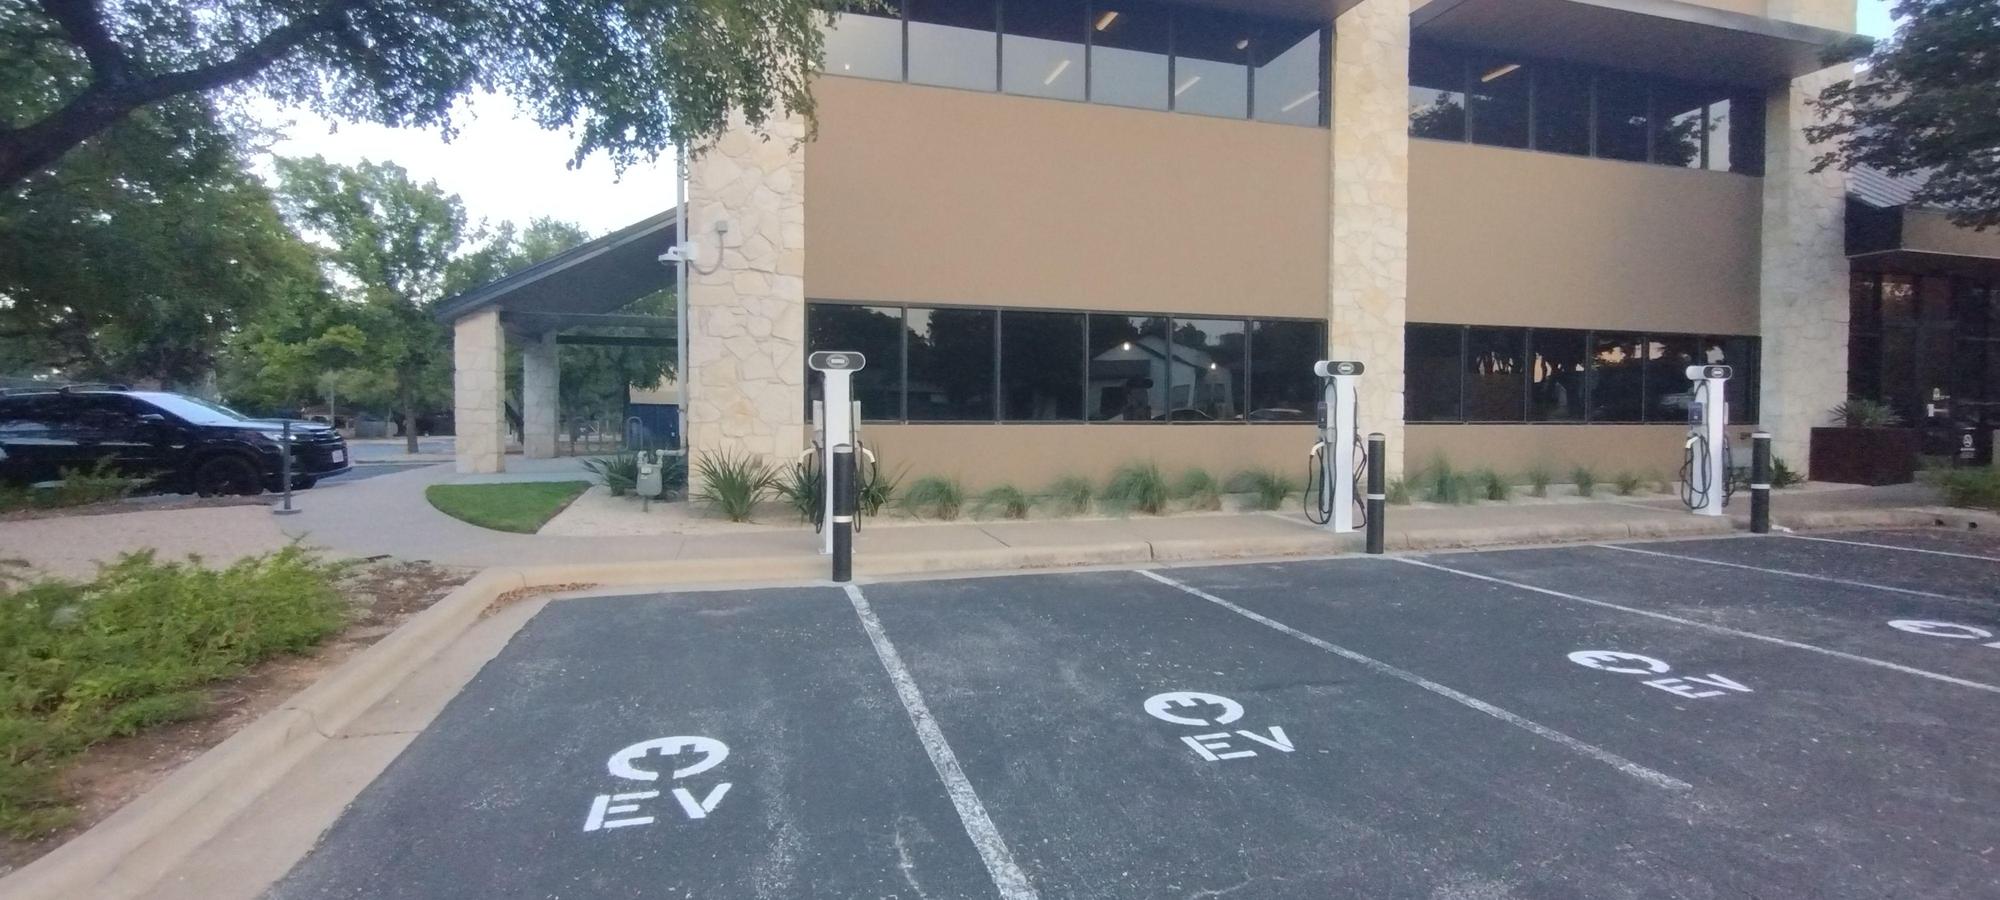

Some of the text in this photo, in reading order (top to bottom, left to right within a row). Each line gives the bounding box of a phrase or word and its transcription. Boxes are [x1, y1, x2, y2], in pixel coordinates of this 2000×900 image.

[1642, 673, 1754, 699] EV
[1180, 725, 1296, 762] EV
[583, 782, 733, 832] EV
